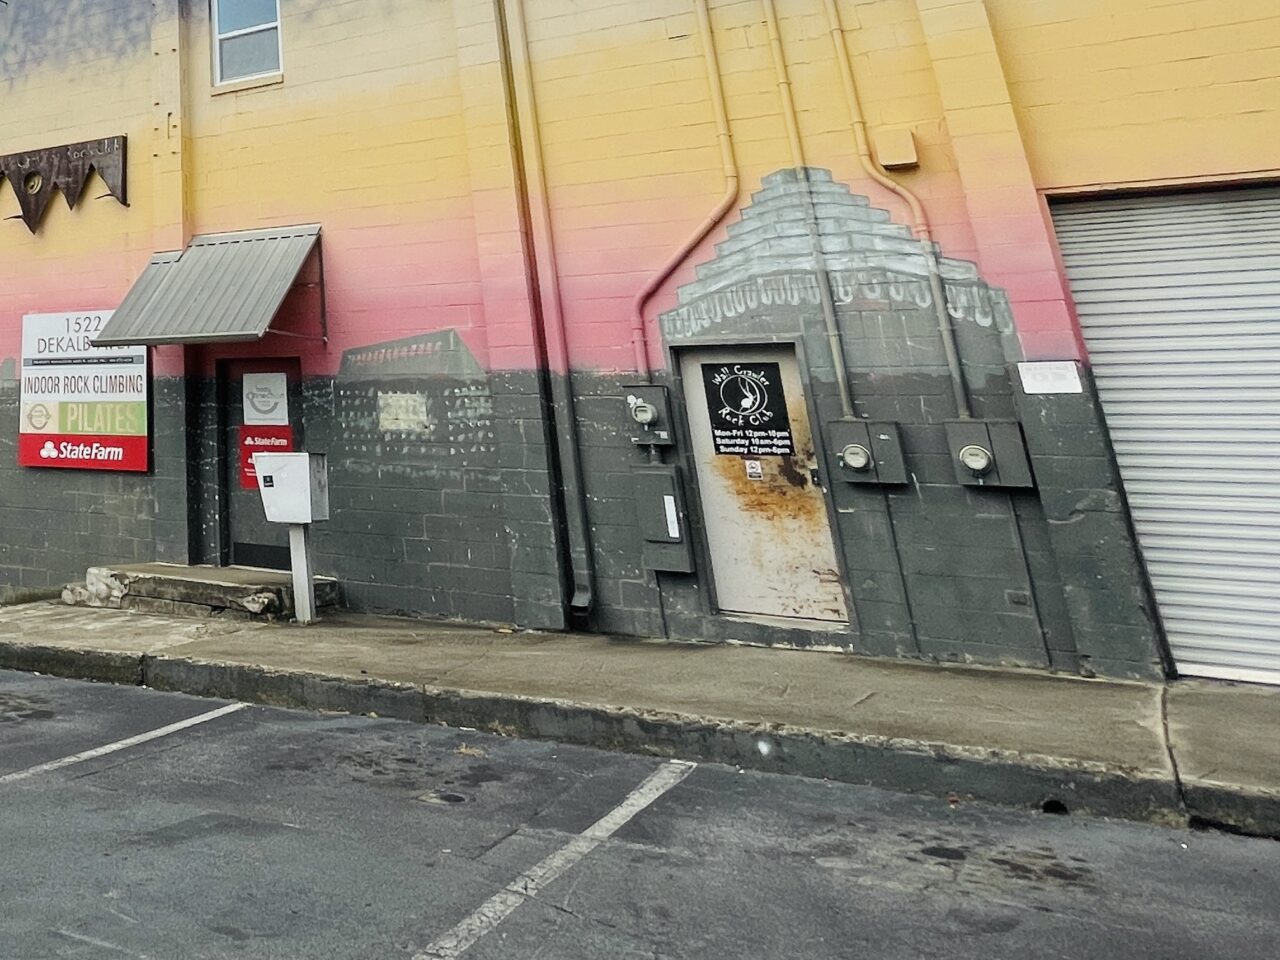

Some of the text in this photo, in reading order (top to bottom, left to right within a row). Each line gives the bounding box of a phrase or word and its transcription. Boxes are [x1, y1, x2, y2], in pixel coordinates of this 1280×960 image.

[65, 315, 102, 333] 1522
[37, 335, 91, 354] DEKALB
[24, 374, 143, 394] INDOOR ROCK CLIMBING
[712, 365, 770, 386] Wall Crawler
[67, 402, 138, 433] PILATES
[718, 407, 774, 426] Rock Club
[716, 437, 749, 446] Saturday
[719, 445, 748, 454] Sunday
